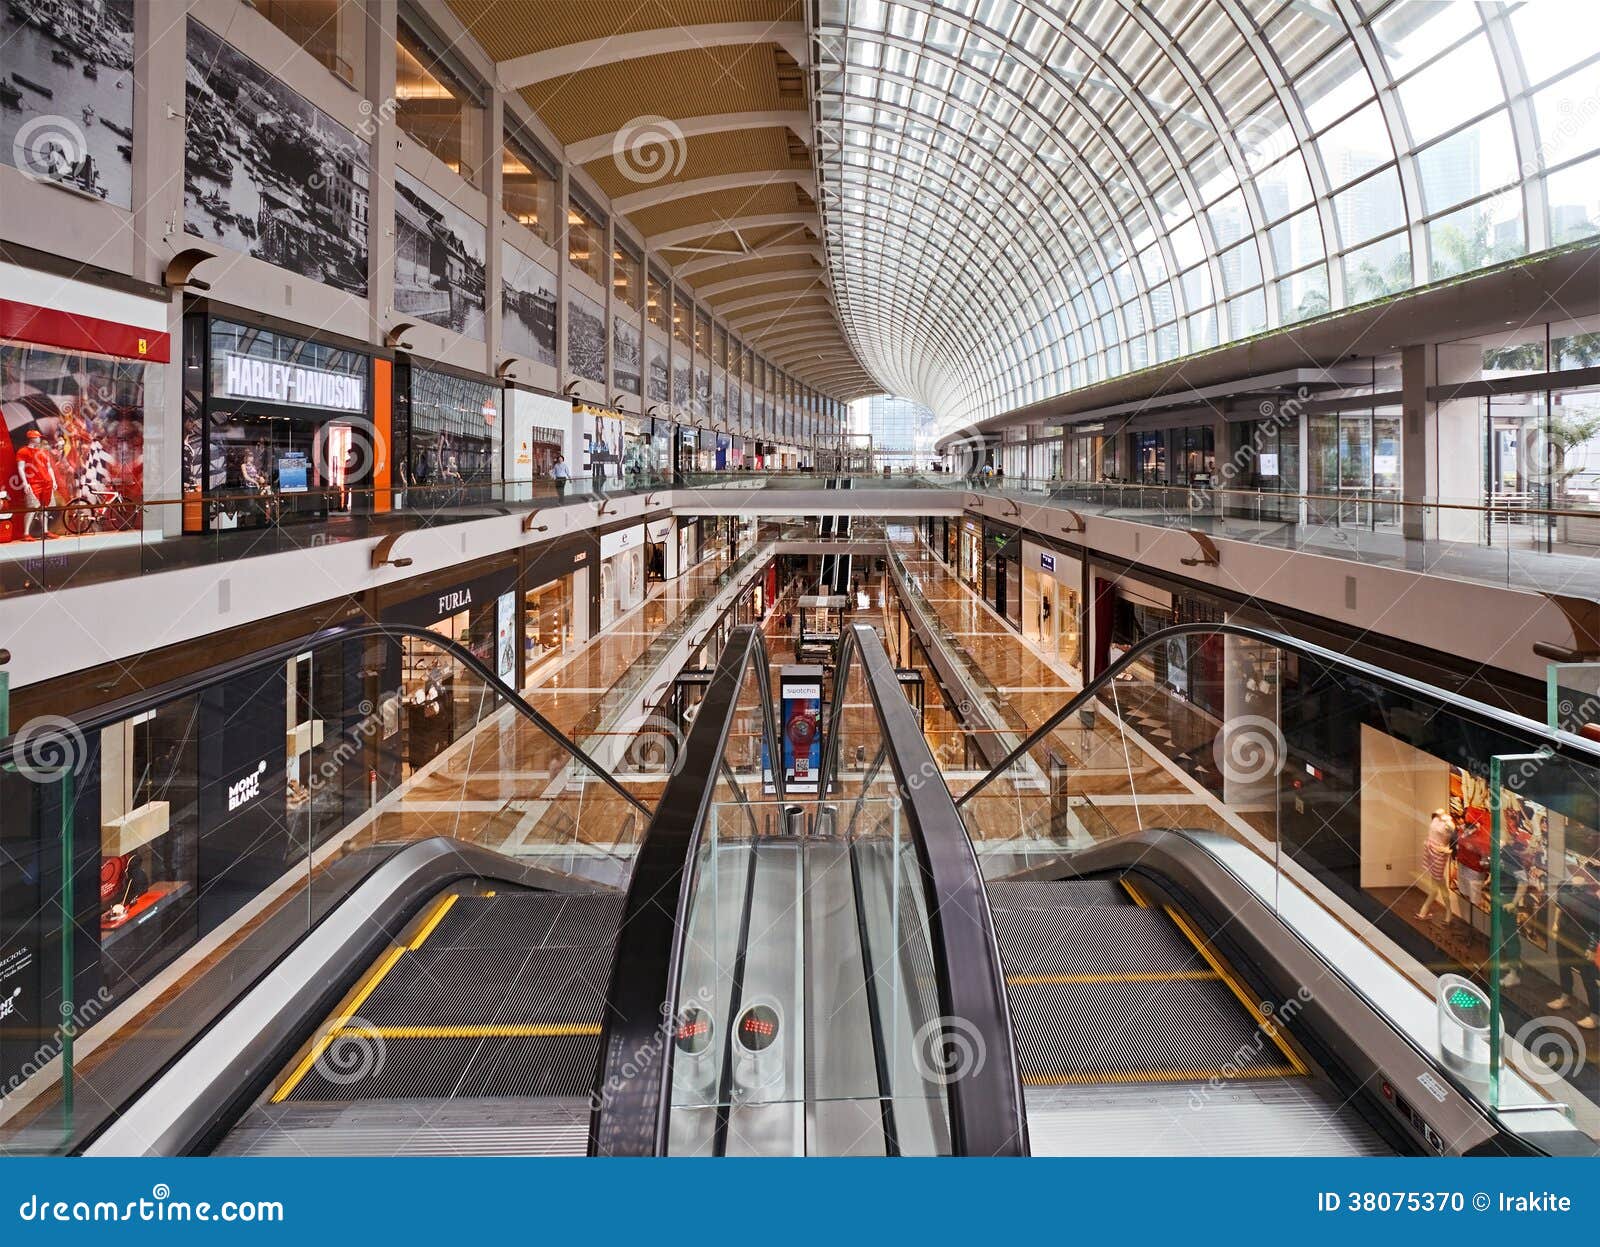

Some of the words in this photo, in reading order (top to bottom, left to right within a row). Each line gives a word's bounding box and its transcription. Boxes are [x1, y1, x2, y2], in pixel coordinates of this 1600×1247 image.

[227, 356, 361, 410] HARLEY-DAVIDSON
[438, 588, 472, 614] FURLA
[229, 771, 260, 799] MONT
[229, 782, 260, 811] BLANC
